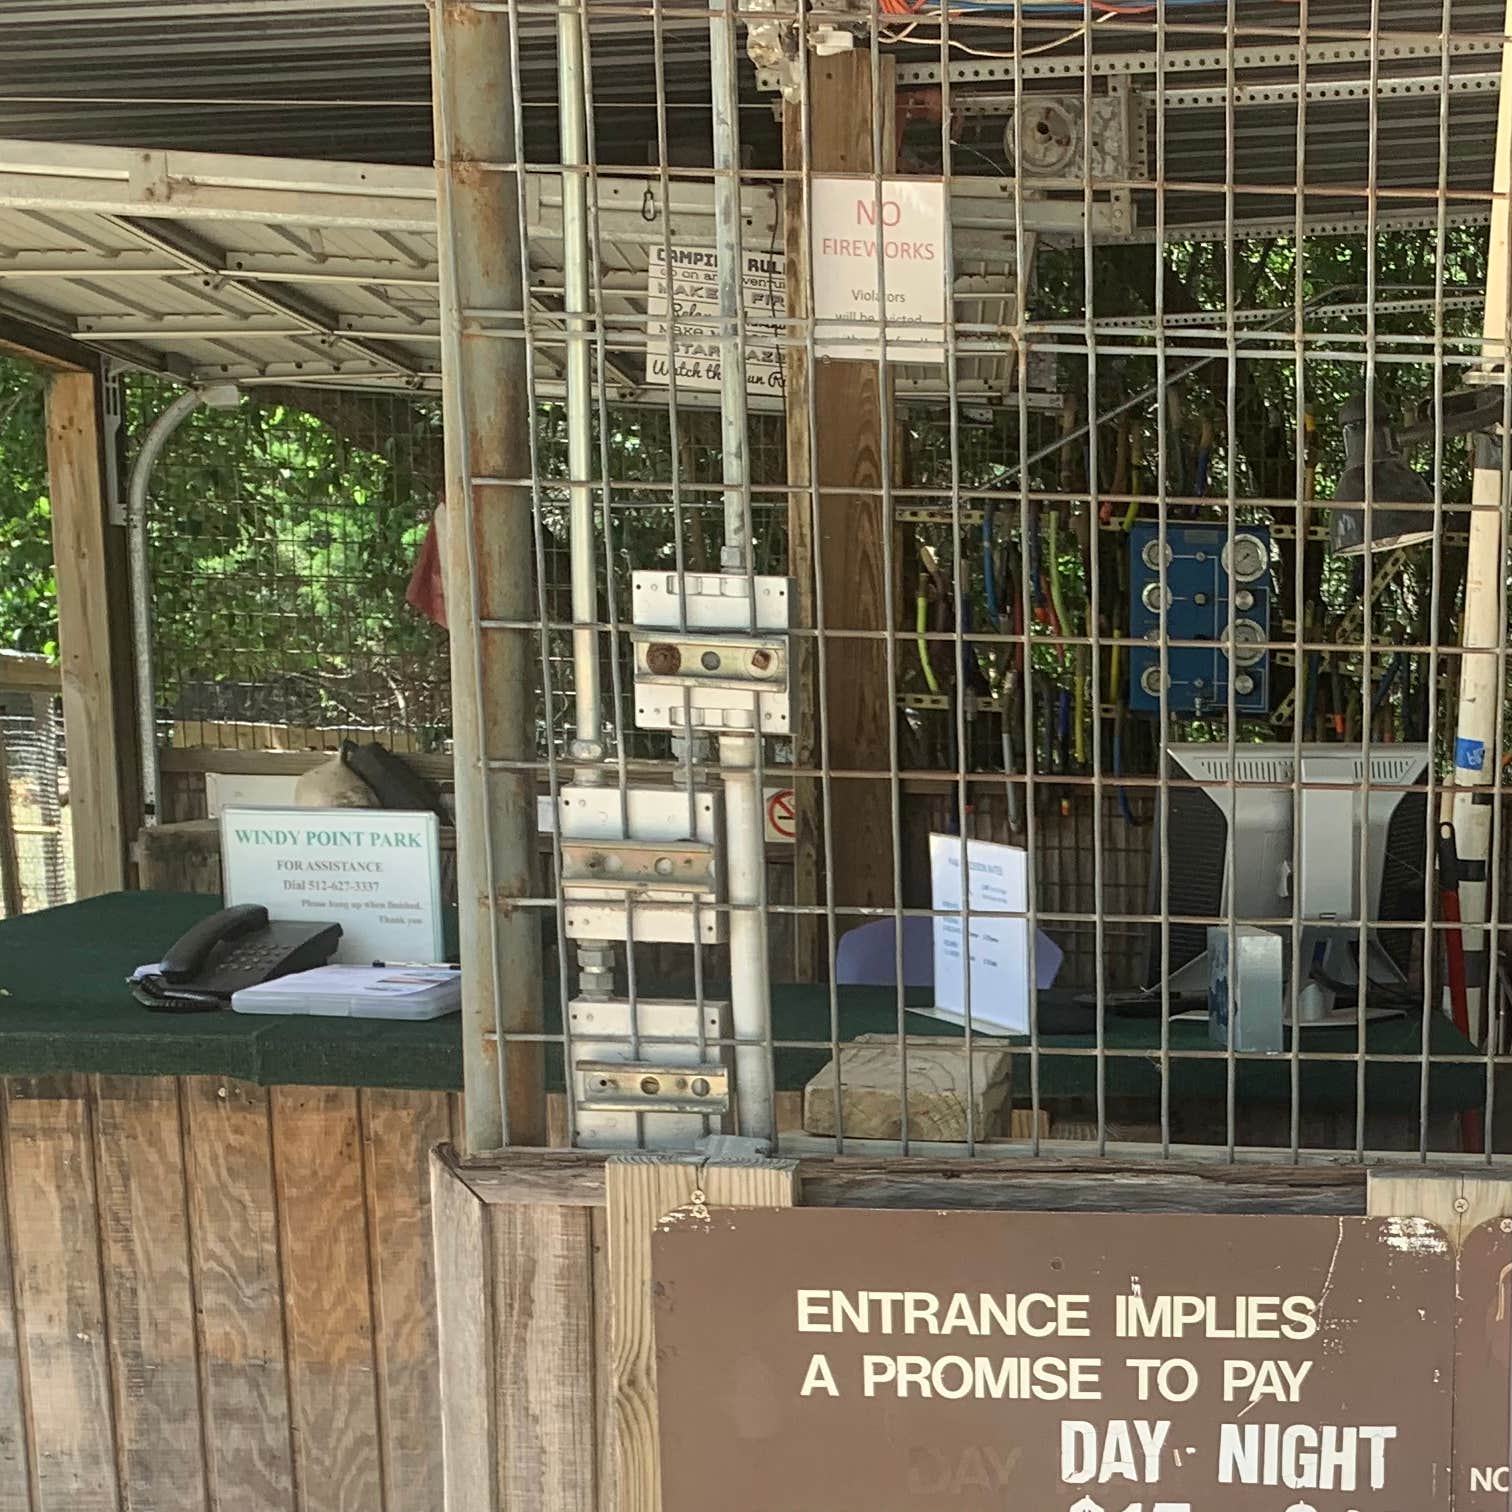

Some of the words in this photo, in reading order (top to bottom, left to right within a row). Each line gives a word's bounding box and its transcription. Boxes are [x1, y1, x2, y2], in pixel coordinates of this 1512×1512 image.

[857, 199, 901, 227] NO
[822, 238, 935, 260] FIREWORKS
[656, 248, 718, 267] CAMPI
[748, 258, 786, 275] RUL
[752, 292, 786, 308] FIR
[852, 289, 906, 303] Violaors
[235, 829, 299, 846] WINDY
[306, 830, 364, 847] POINT
[370, 831, 423, 848] PARK
[277, 860, 303, 871] FOR
[306, 860, 384, 873] ASSISTANCE
[283, 880, 305, 891] Dial
[798, 1290, 1090, 1337] ENTRANCE
[1117, 1295, 1316, 1339] IMPLIES
[801, 1355, 839, 1396] A
[864, 1356, 1101, 1400] PROMISE
[1126, 1359, 1198, 1401] TO
[1224, 1360, 1312, 1402] PAY
[1062, 1420, 1170, 1483] DAY
[1218, 1424, 1396, 1491] NIGHT
